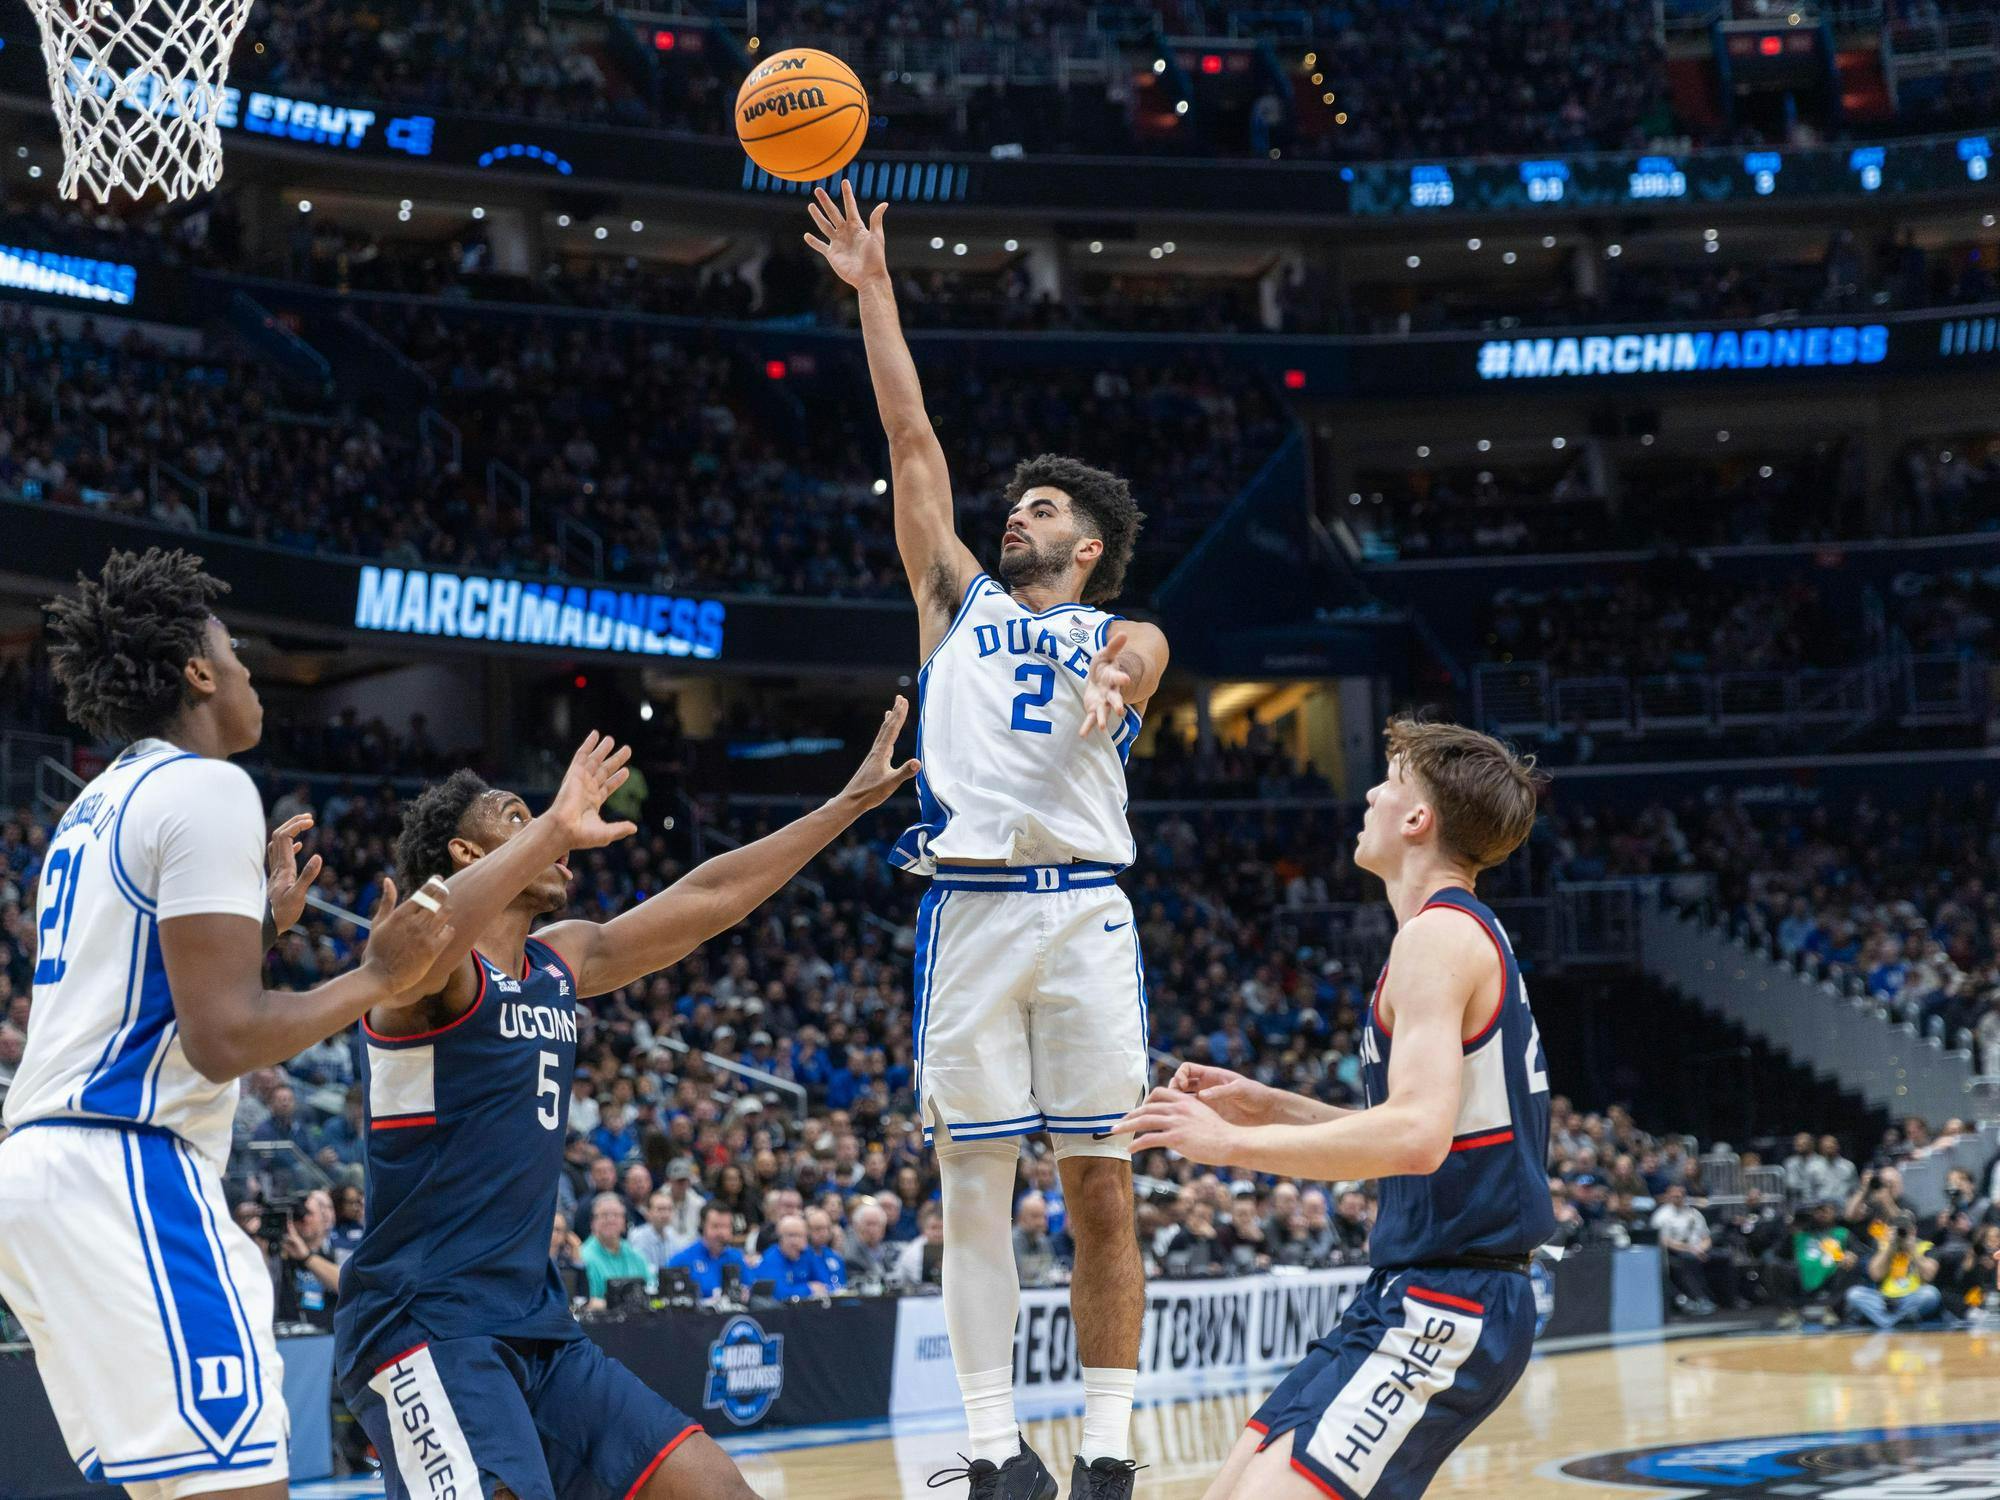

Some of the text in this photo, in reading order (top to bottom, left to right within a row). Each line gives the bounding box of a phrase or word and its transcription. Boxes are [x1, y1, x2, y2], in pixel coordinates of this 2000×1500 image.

[243, 91, 375, 149] EIGHT
[743, 86, 828, 123] Wilson
[1476, 324, 1890, 380] #MARCHMADNESS
[1010, 662, 1056, 735] 2
[32, 842, 86, 986] 21
[500, 1002, 578, 1043] UCONN
[536, 1050, 561, 1131] 5
